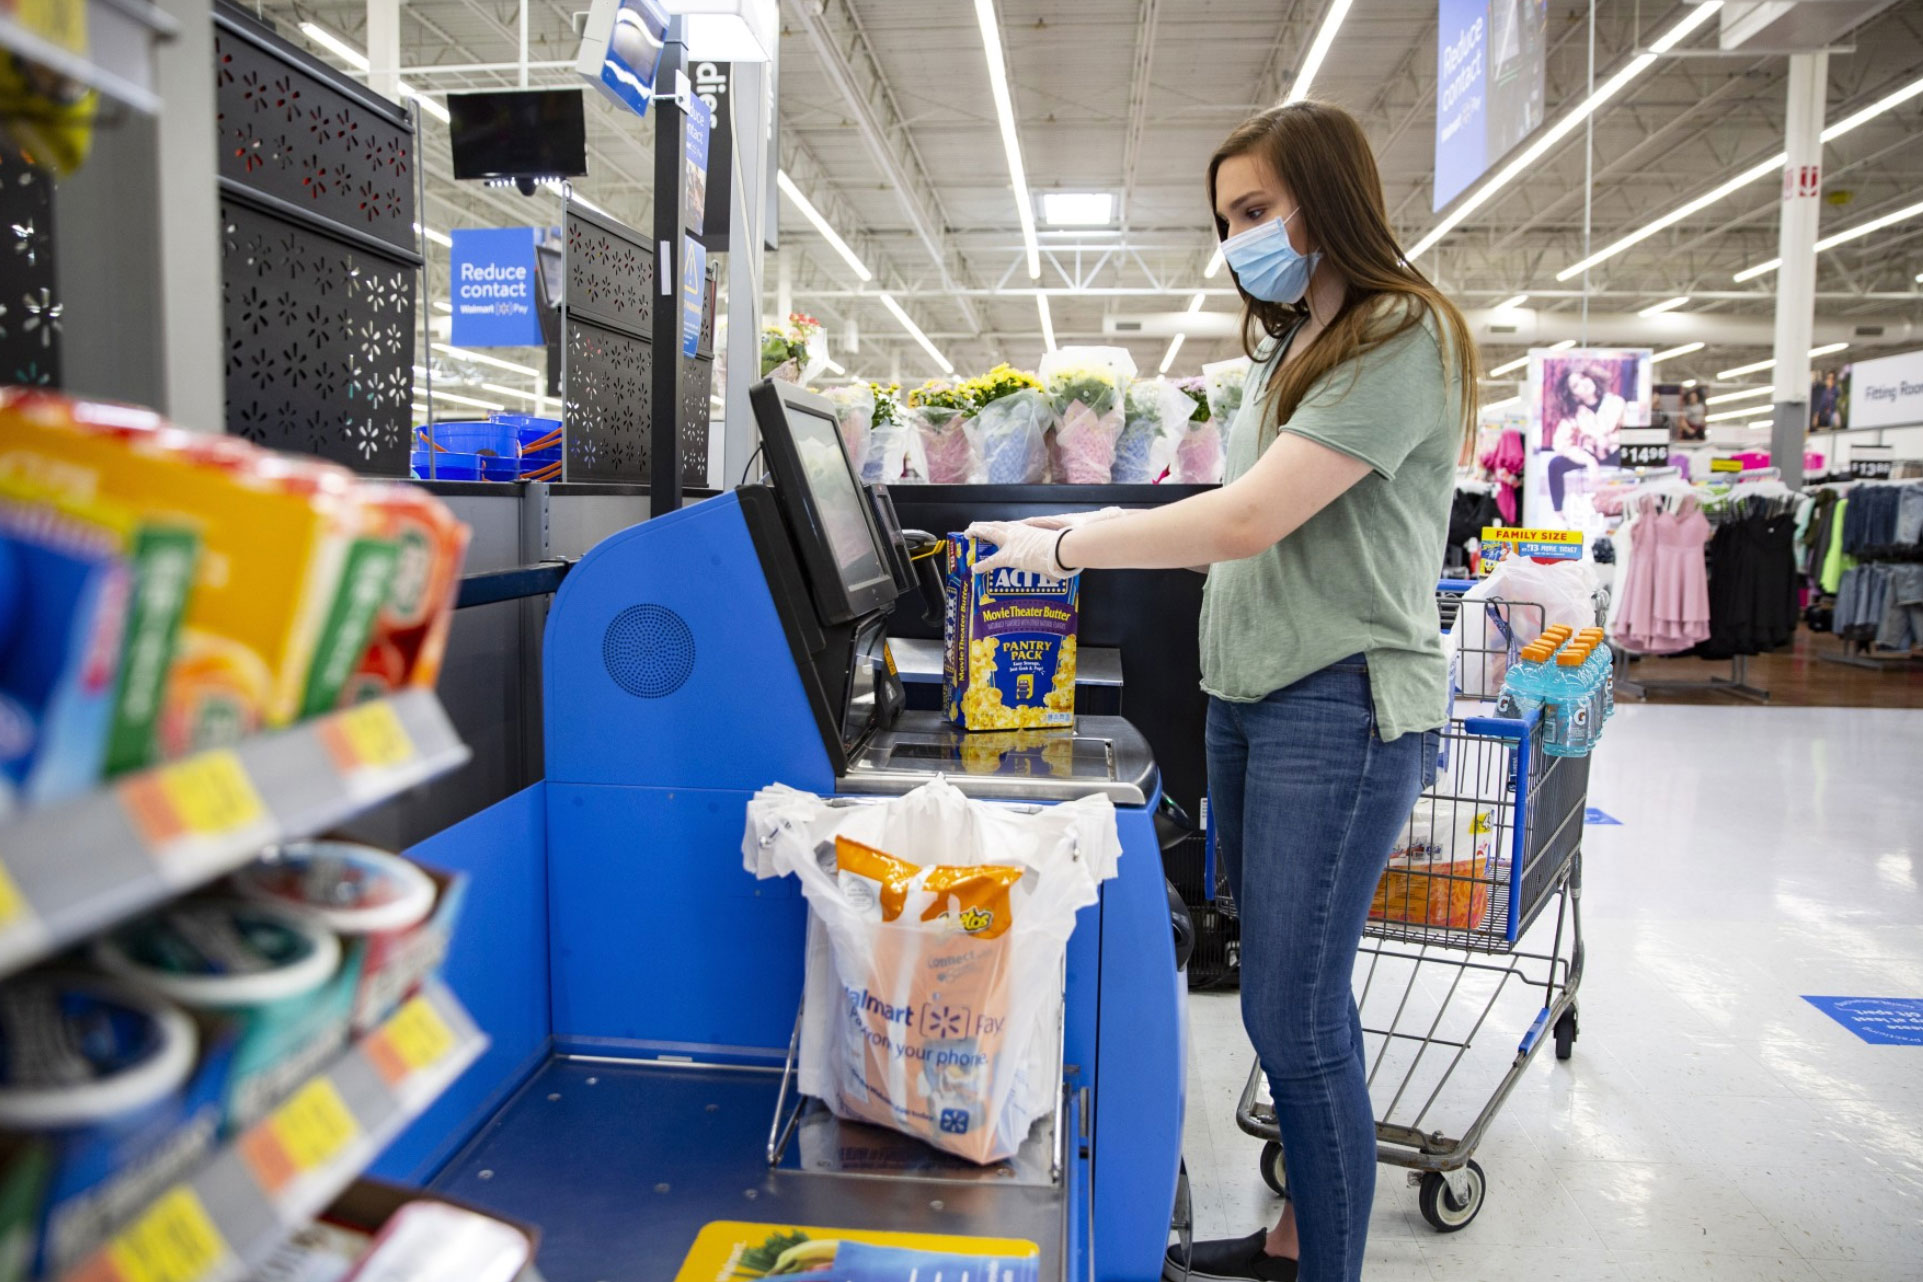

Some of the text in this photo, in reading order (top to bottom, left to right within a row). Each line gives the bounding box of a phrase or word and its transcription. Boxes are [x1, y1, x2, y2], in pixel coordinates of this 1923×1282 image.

[1443, 16, 1483, 80] Reduce
[1442, 48, 1482, 113] contact
[461, 261, 527, 281] Reduce
[460, 281, 527, 298] contact
[1864, 385, 1897, 403] Fitting
[1495, 530, 1568, 541] FAMILY SIZE
[995, 569, 1033, 588] ACT
[960, 581, 968, 613] Butter
[983, 606, 1072, 623] Movie Theater Butter
[1003, 640, 1053, 652] PANTRY
[1011, 650, 1043, 660] PACK
[1574, 708, 1586, 725] G
[845, 986, 914, 1027] almart
[896, 1042, 934, 1062] your
